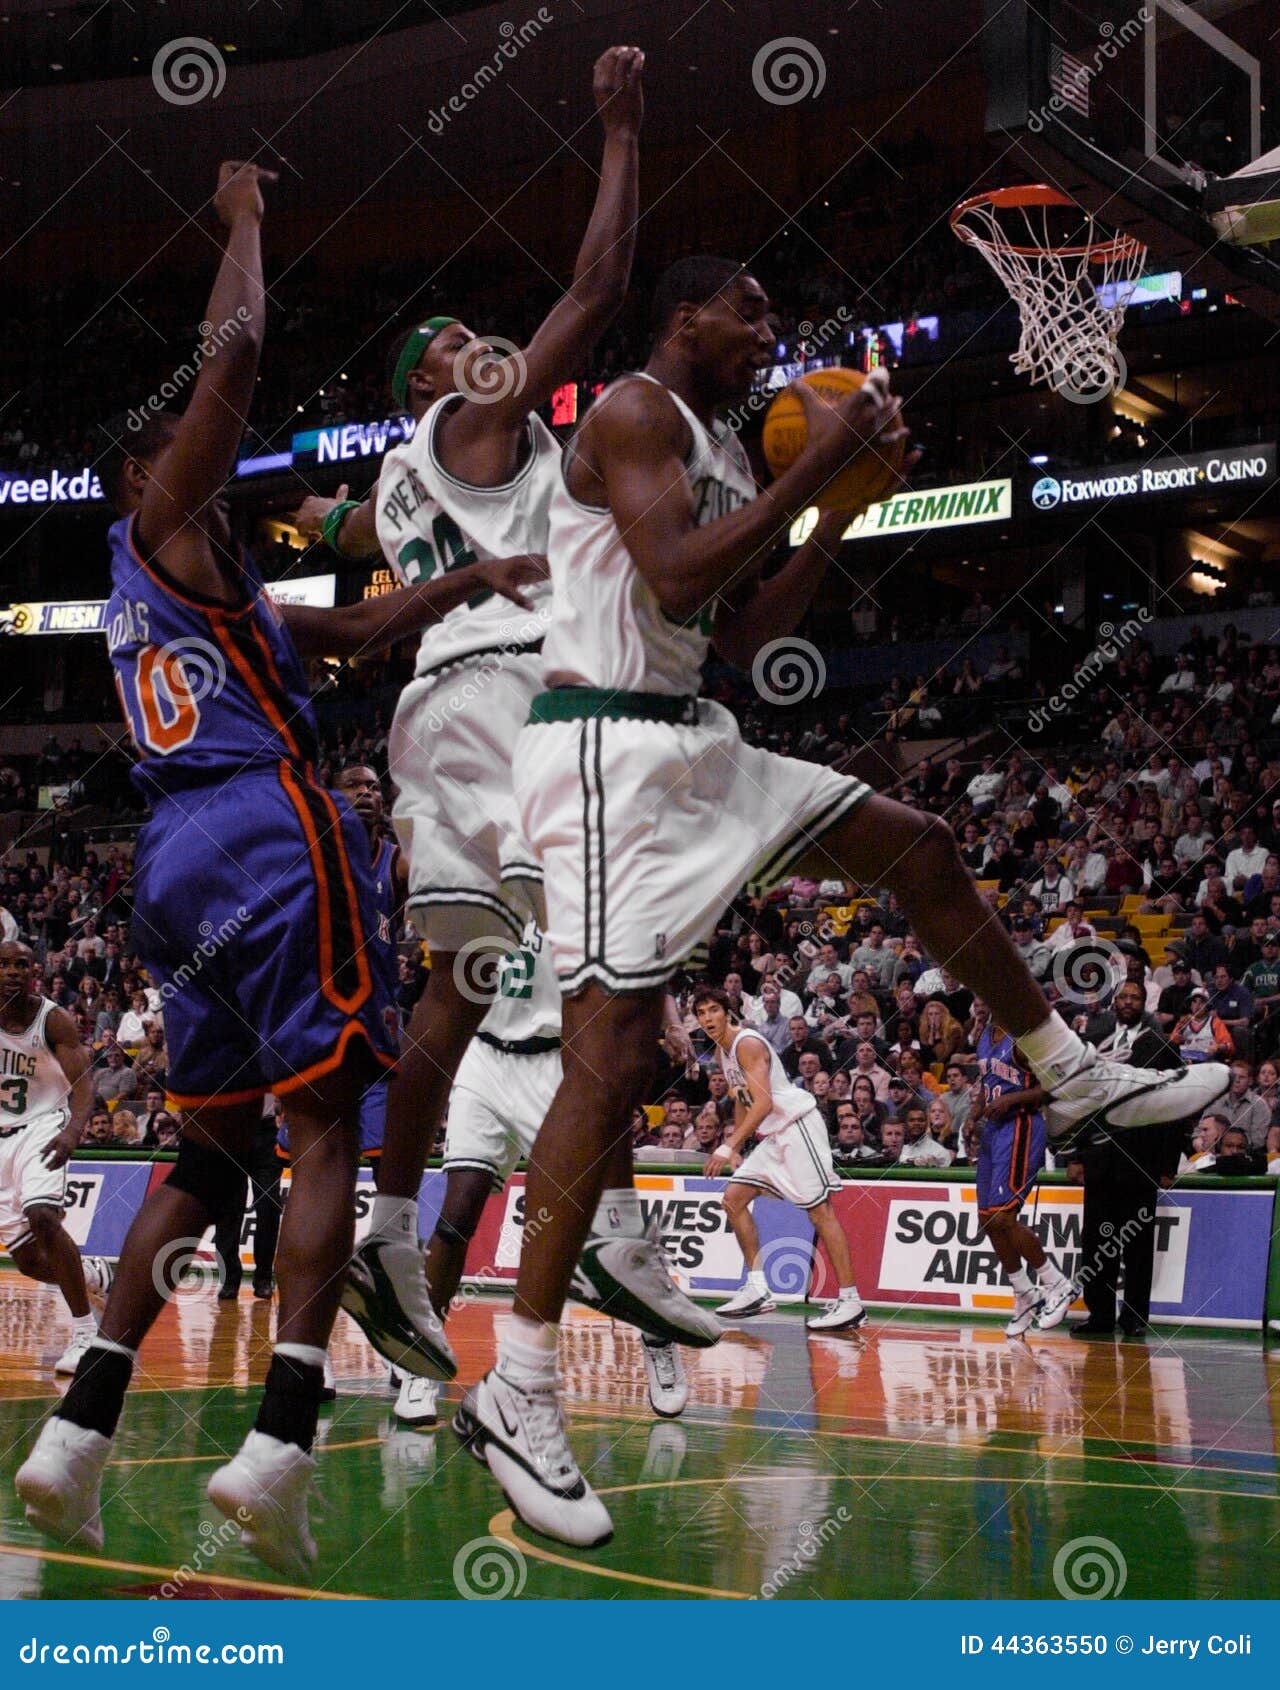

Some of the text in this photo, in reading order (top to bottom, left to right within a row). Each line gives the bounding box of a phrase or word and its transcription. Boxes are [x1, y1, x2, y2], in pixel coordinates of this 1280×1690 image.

[1062, 457, 1268, 503] FOXWOODS RESORT CASINO
[50, 606, 101, 629] NESN
